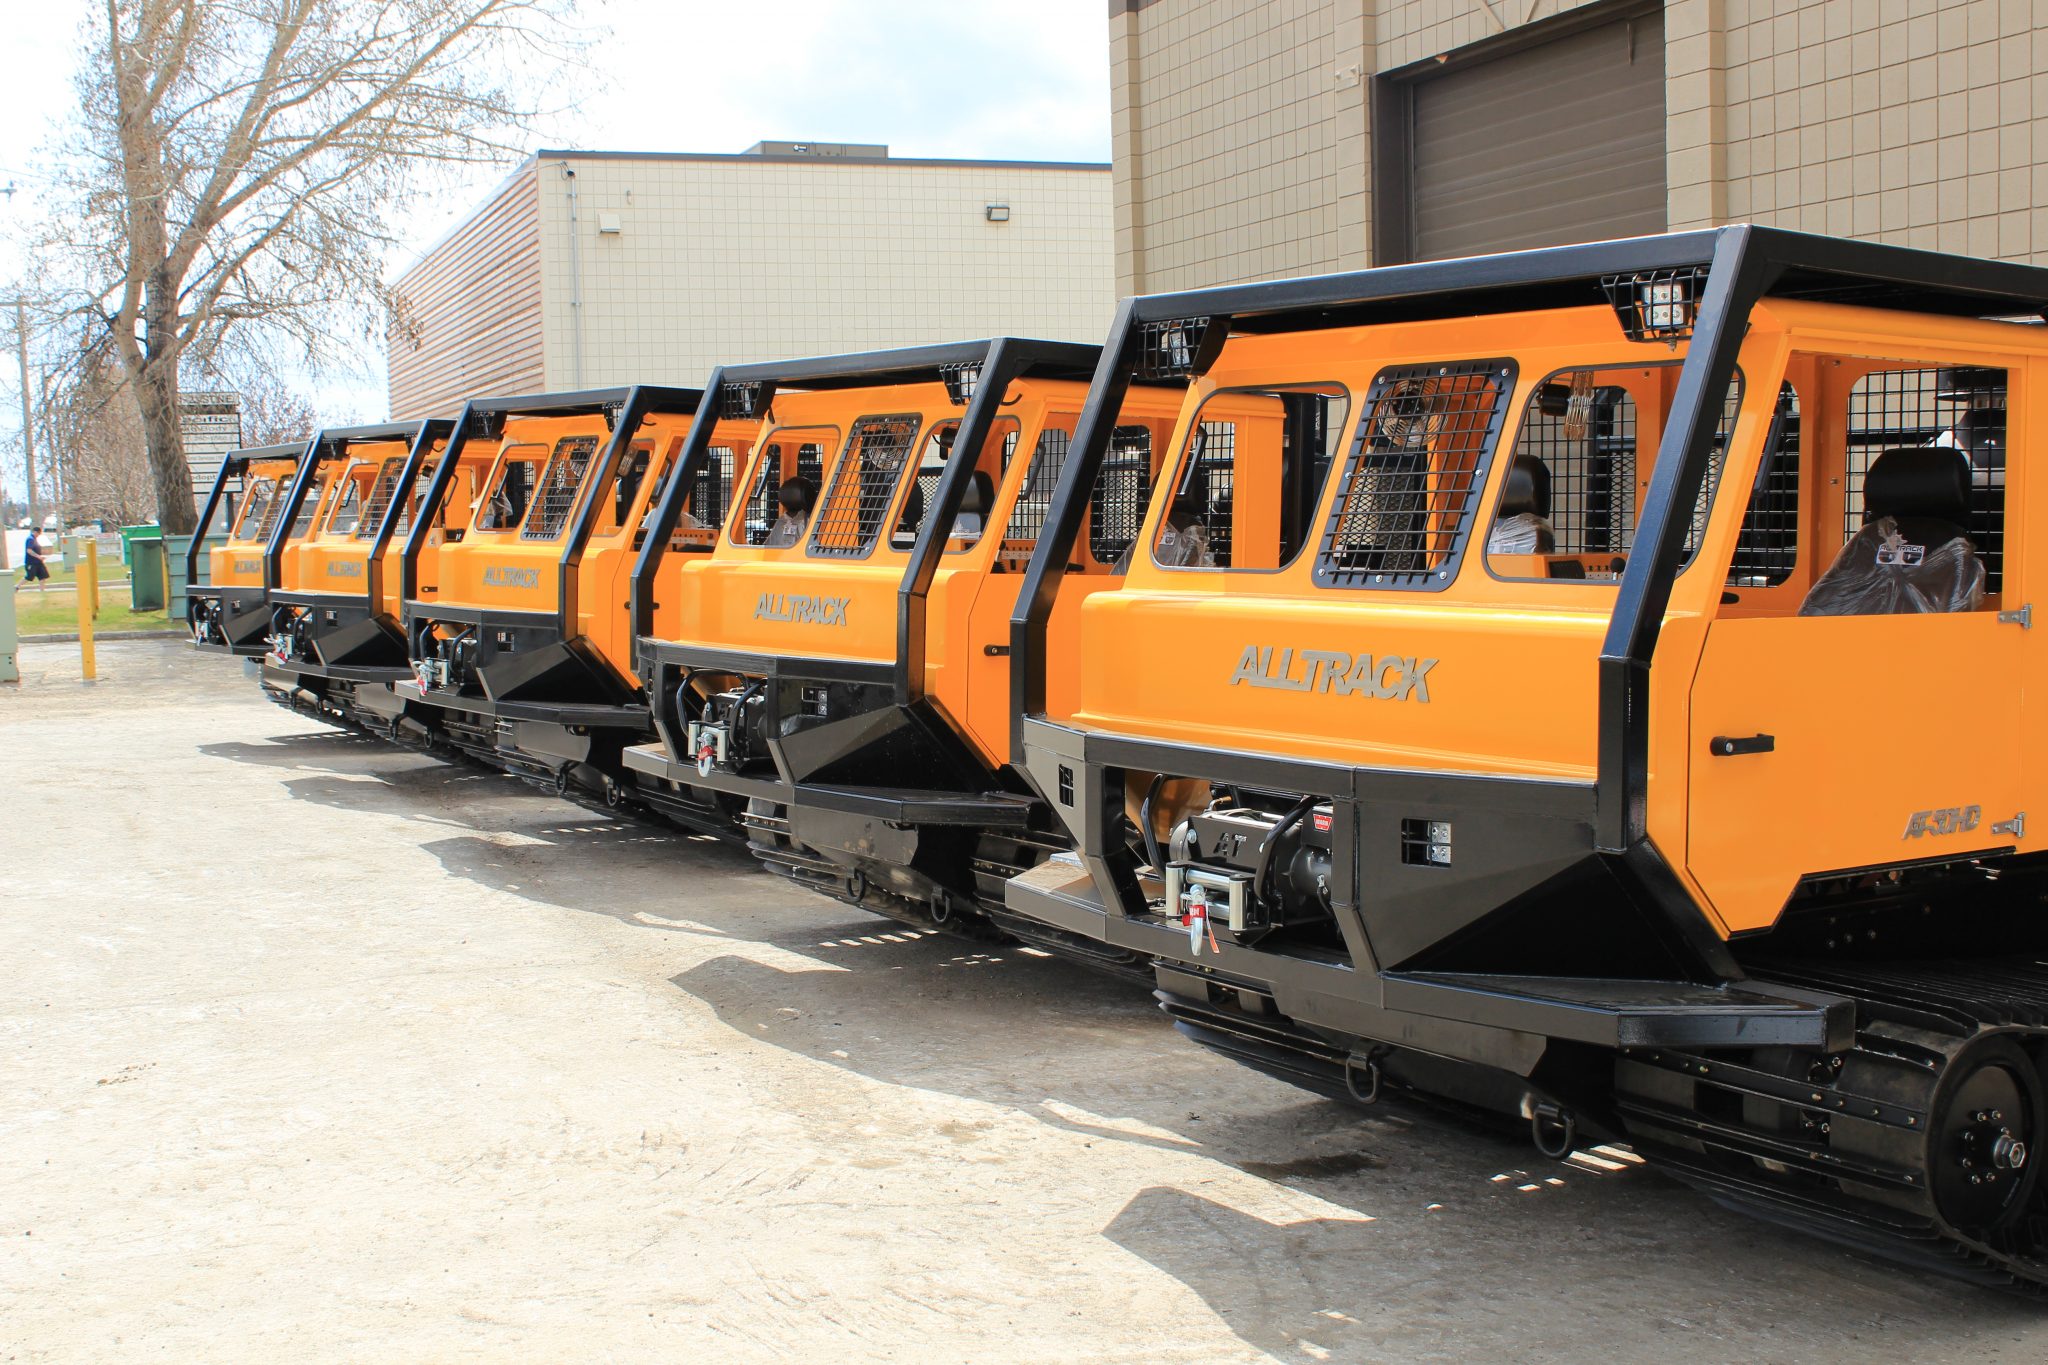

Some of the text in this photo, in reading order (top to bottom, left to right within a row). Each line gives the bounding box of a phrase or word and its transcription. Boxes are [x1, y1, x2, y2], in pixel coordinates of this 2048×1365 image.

[482, 567, 541, 589] ALLTRACK
[753, 592, 851, 626] ALLTRACK
[1229, 645, 1440, 703] ALLTRACK
[1213, 832, 1248, 857] AT
